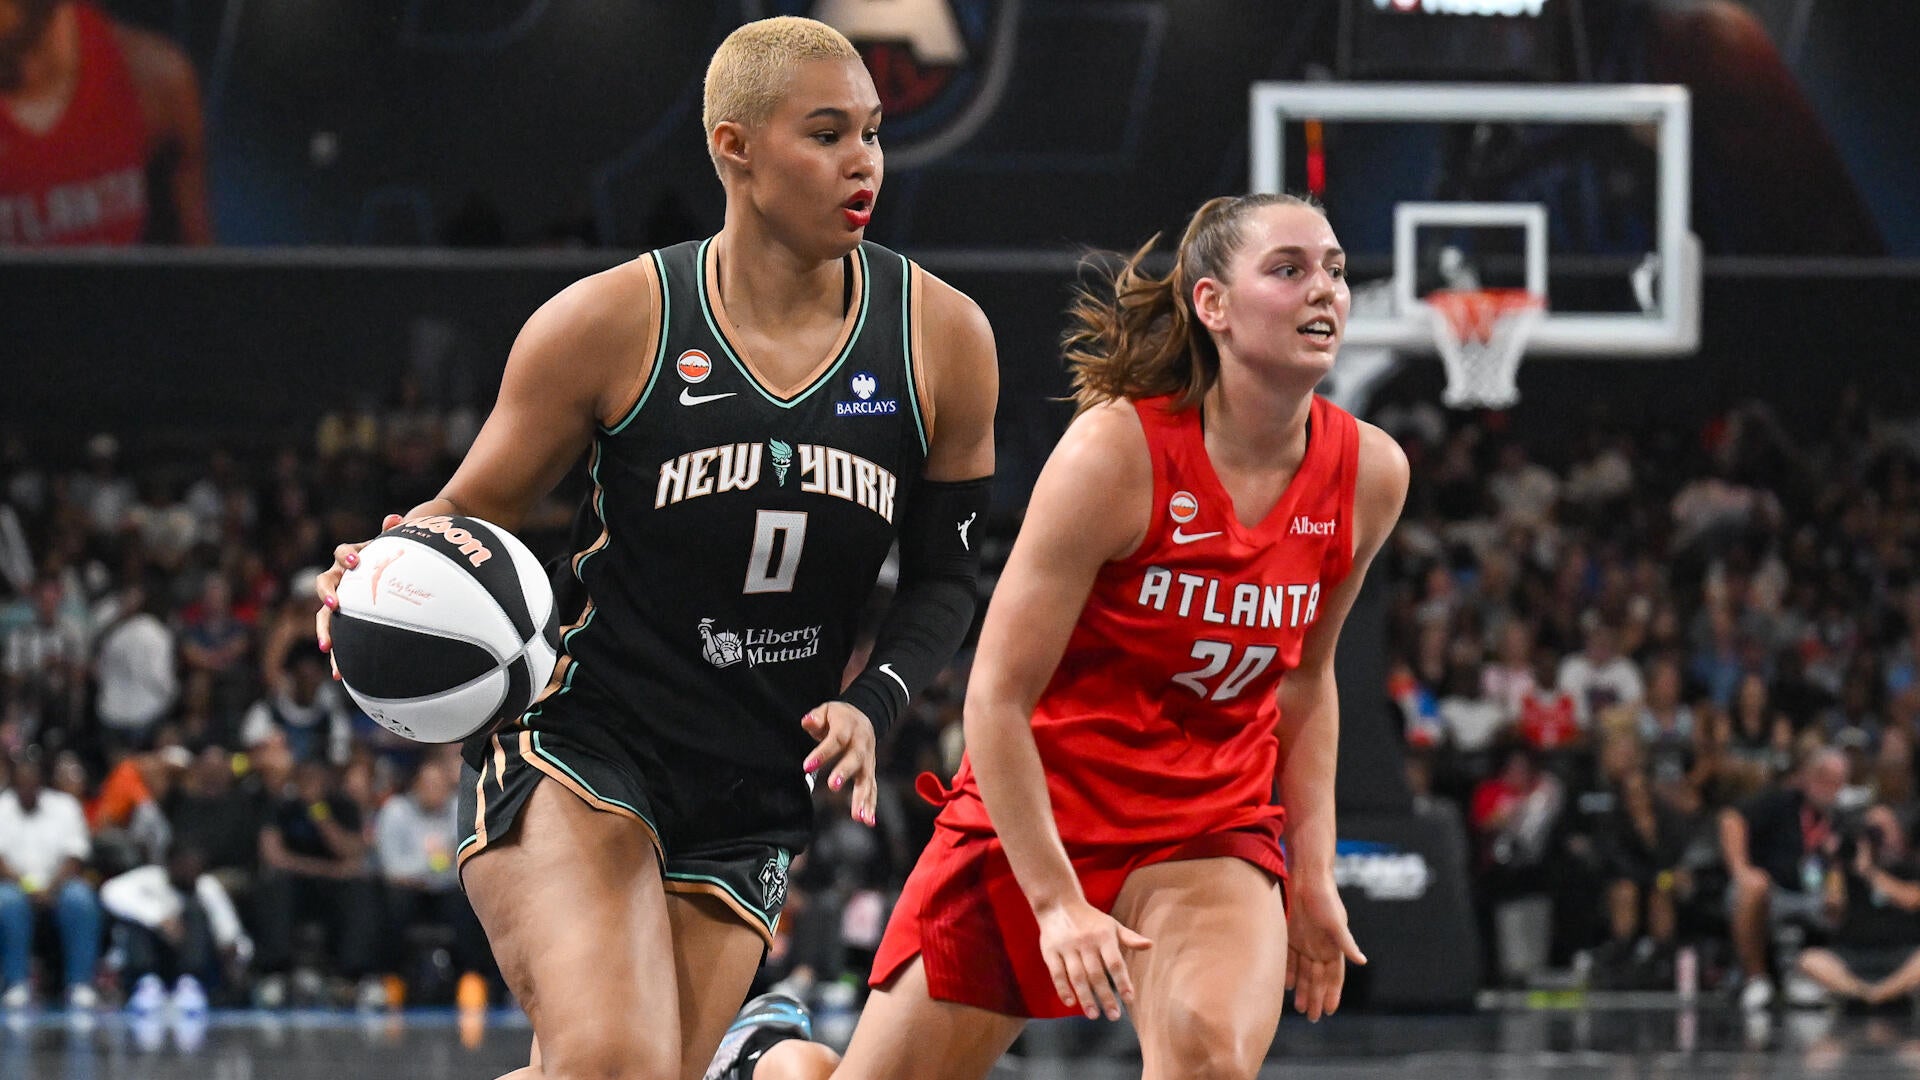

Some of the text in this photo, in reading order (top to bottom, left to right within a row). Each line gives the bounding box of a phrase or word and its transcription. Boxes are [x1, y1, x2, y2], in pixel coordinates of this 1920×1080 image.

[837, 401, 896, 415] BARCLAYS
[655, 442, 897, 526] NEW YORK
[402, 515, 493, 568] ilson
[743, 509, 809, 594] 0
[1290, 516, 1336, 535] Albert
[1138, 565, 1321, 628] ATLANTA
[745, 625, 822, 646] Liberty
[747, 638, 820, 668] Mutual
[1171, 640, 1278, 701] 20
